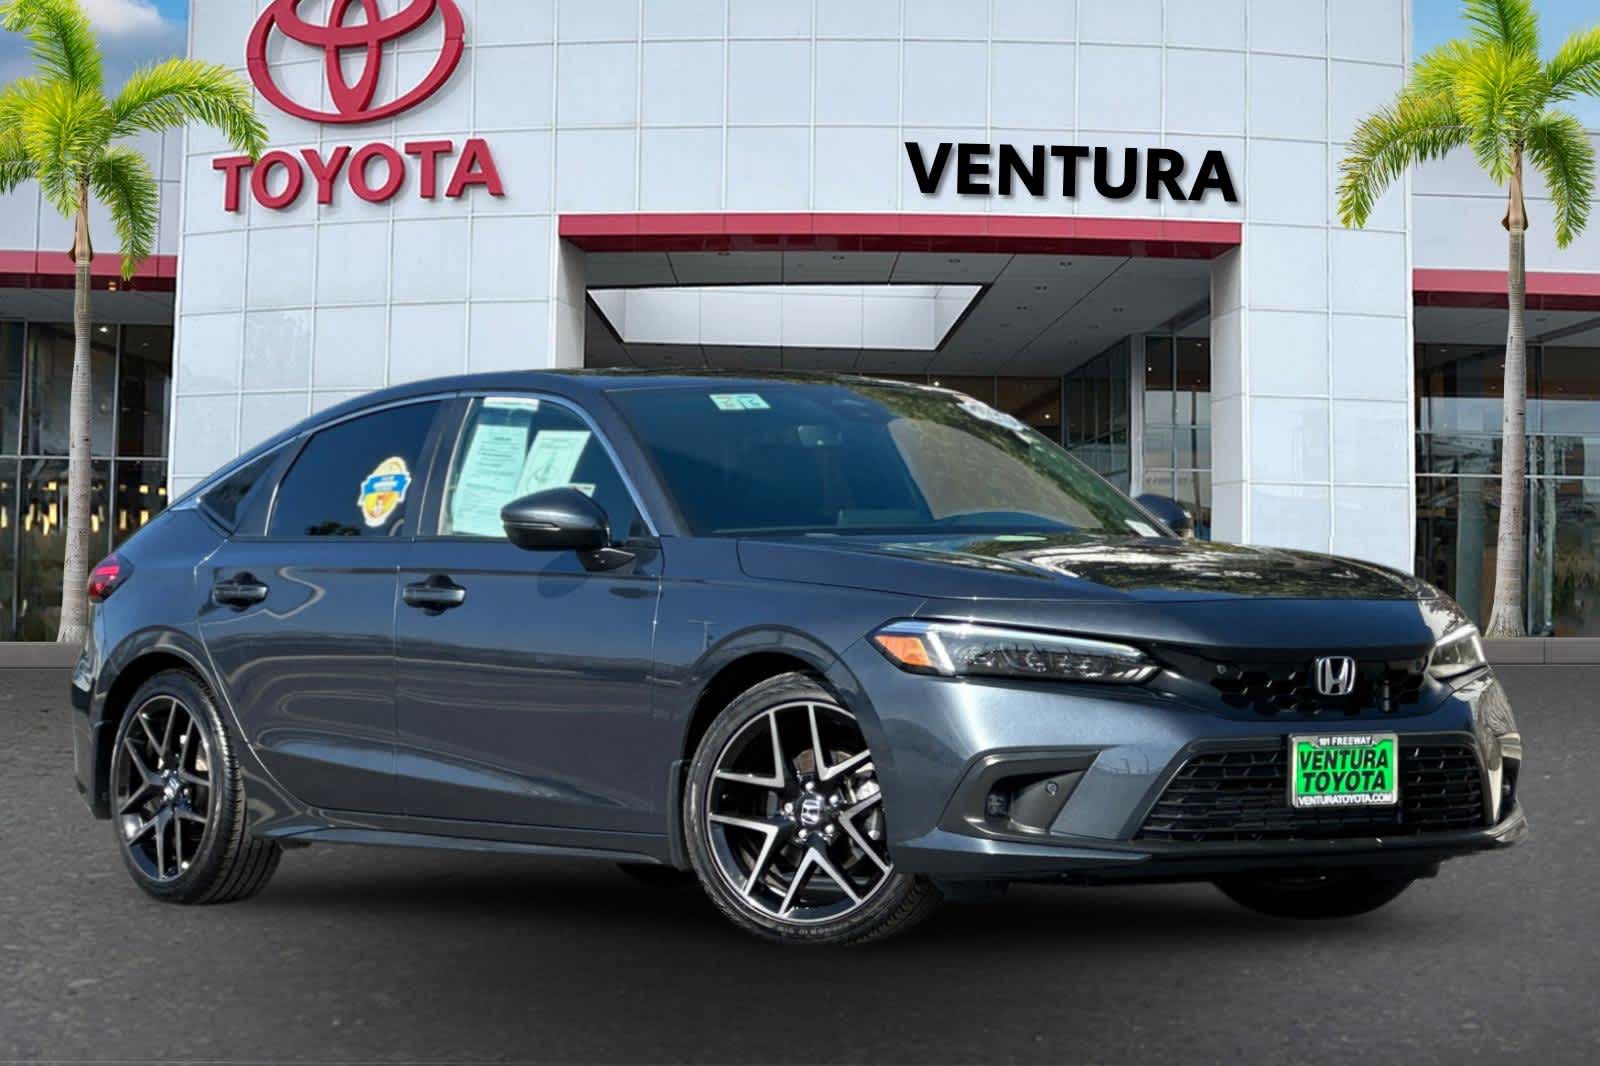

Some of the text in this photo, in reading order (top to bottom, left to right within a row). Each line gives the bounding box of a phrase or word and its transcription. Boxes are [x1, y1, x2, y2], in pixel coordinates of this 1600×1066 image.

[213, 138, 505, 212] TOYOTA
[904, 141, 1239, 203] VENTURA
[1331, 736, 1371, 746] FREEWAY
[1300, 748, 1388, 771] VENTURA
[1303, 770, 1386, 792] TOYOTA
[1298, 792, 1393, 806] VENTURATOYOTA.COM
